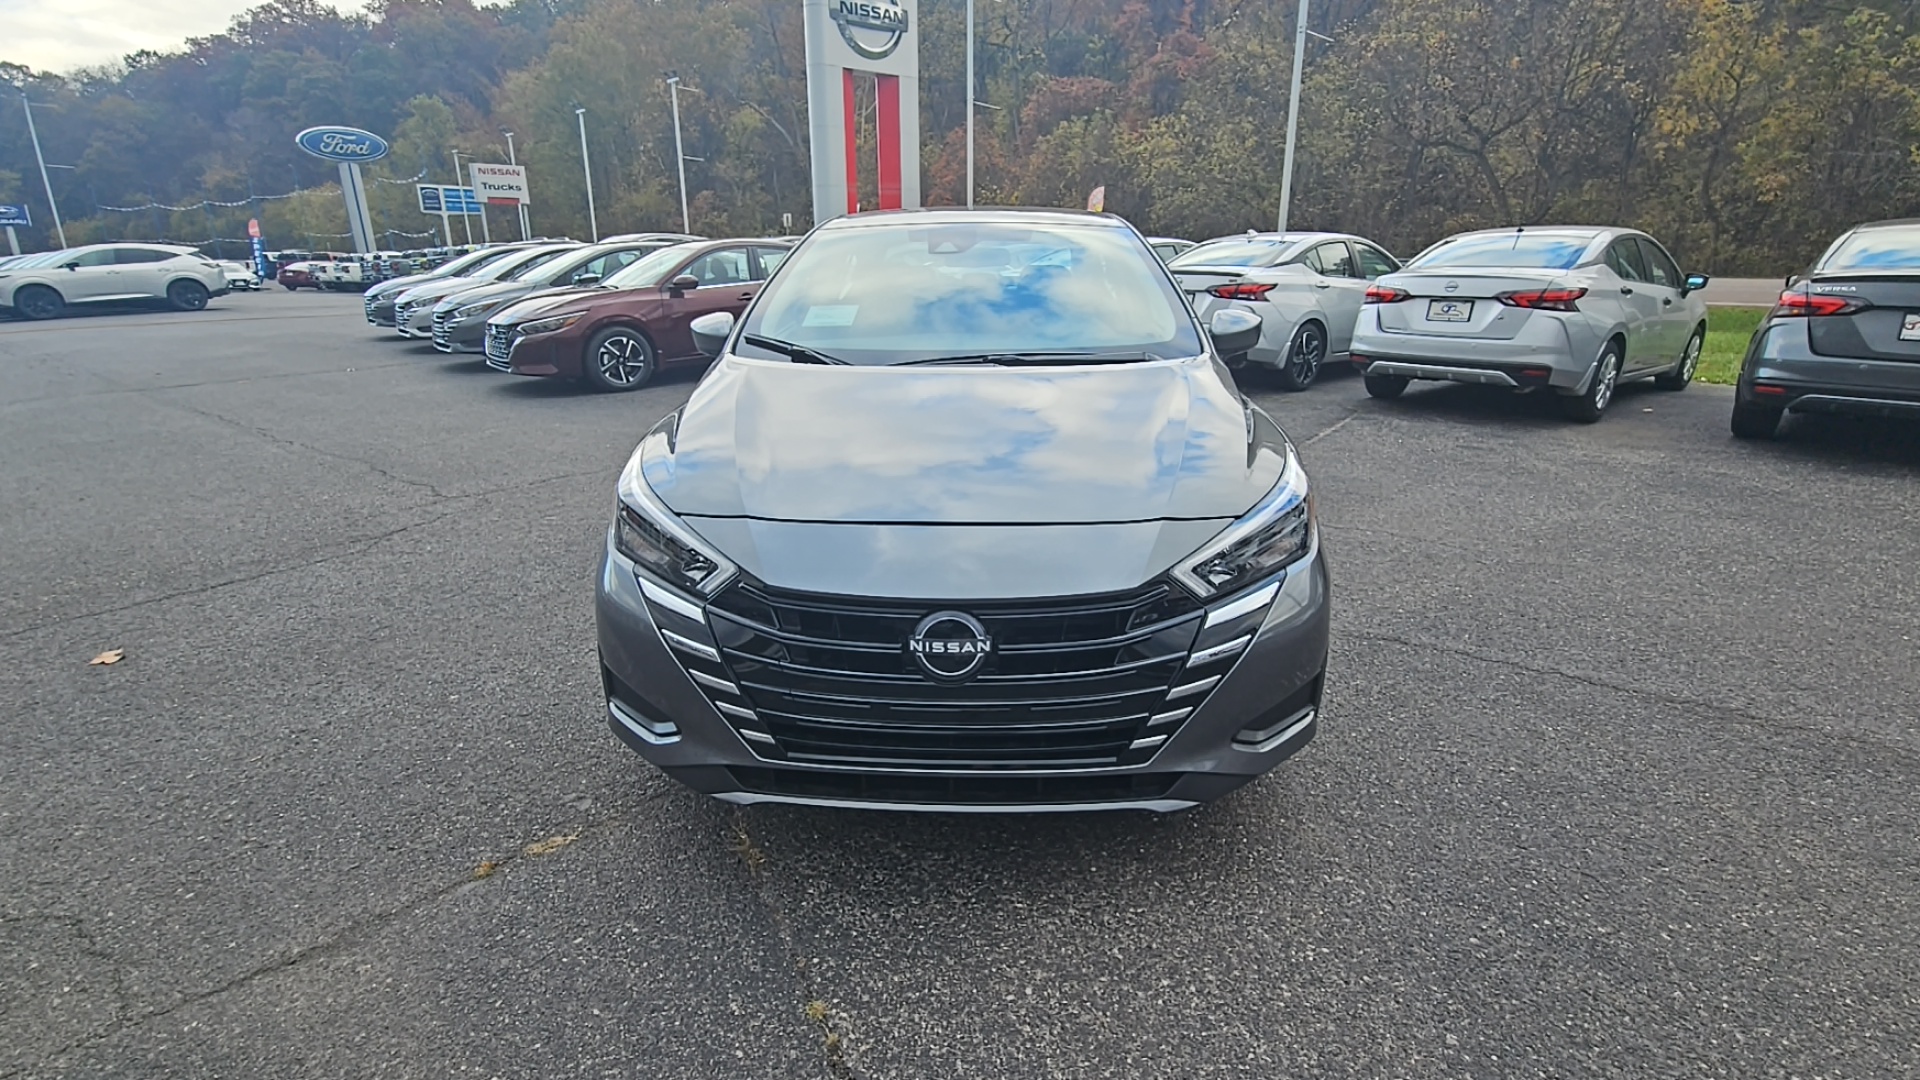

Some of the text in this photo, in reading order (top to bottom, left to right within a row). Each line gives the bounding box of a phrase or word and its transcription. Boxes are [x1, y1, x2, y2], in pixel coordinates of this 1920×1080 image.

[840, 1, 904, 24] NISSAN
[320, 133, 370, 154] Ford
[478, 168, 520, 176] NISSAN
[481, 182, 522, 191] Trucks
[909, 640, 991, 653] NISSAN
